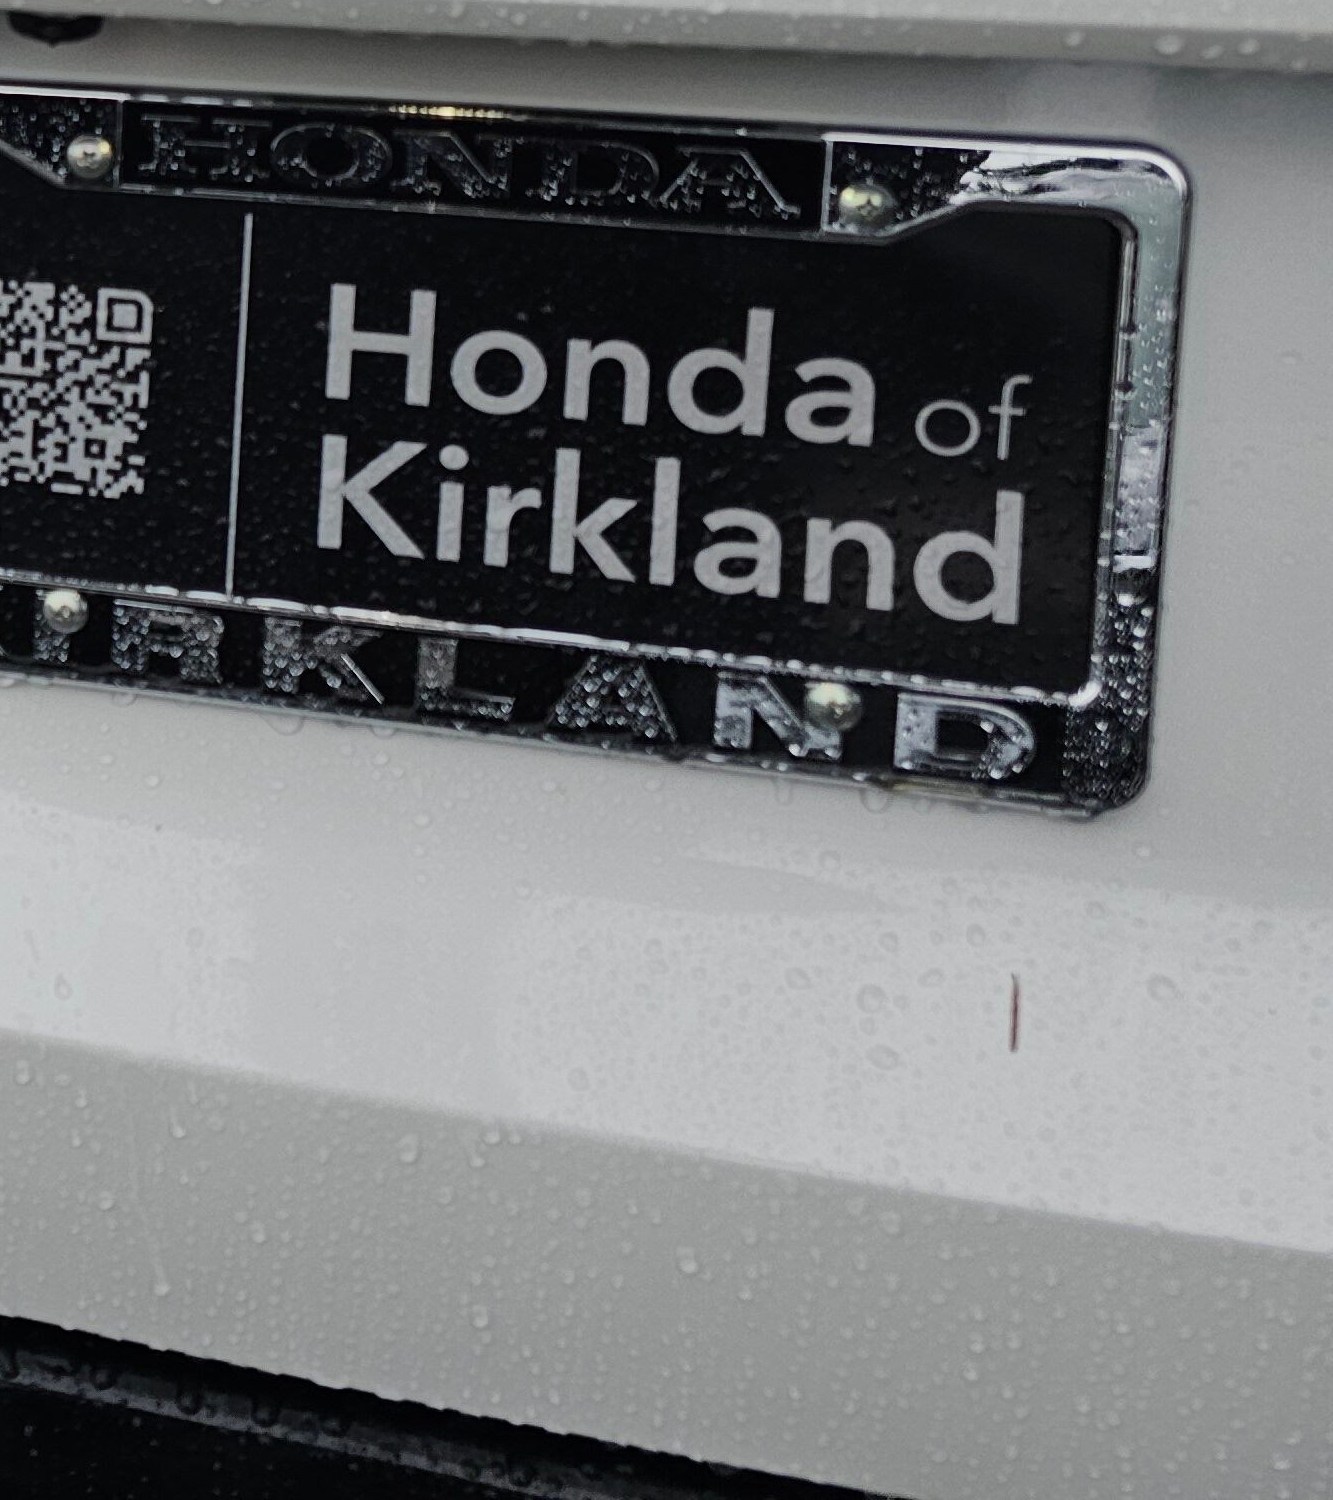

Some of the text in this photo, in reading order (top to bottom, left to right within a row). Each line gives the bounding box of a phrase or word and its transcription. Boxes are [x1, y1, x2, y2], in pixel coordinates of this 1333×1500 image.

[138, 112, 800, 219] HONDA
[326, 283, 1030, 460] Honda of
[317, 434, 1025, 625] Kirkland
